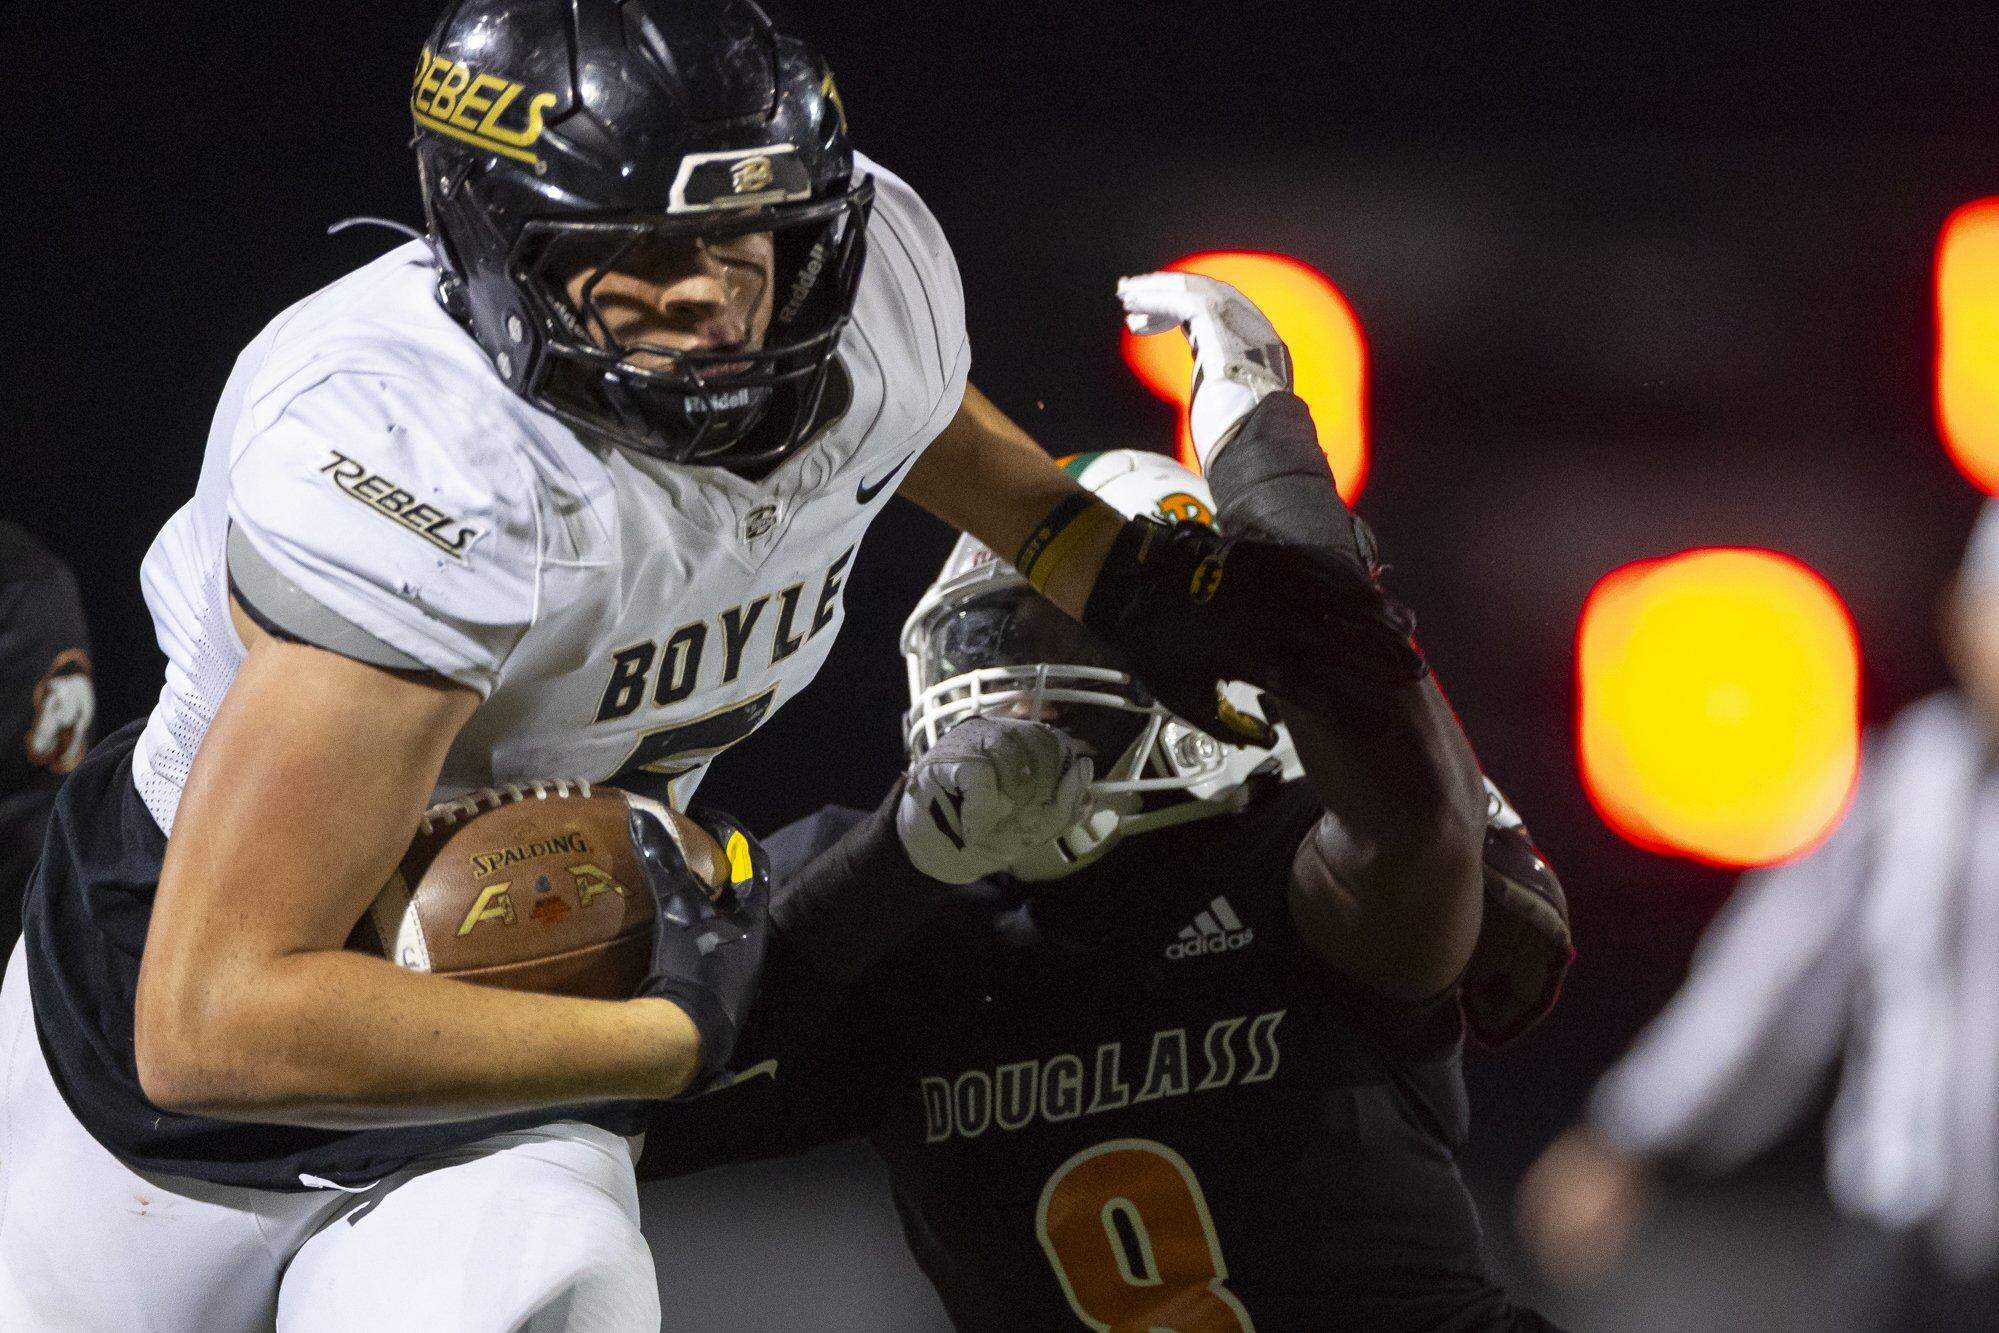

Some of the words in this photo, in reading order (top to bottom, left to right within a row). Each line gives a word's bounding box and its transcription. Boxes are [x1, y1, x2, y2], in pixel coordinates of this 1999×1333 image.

[320, 449, 477, 558] REBELS
[592, 542, 855, 724] BOYLE
[469, 831, 588, 880] SPALDING
[1165, 927, 1254, 960] adidas
[919, 1008, 1288, 1144] DOUGLASS
